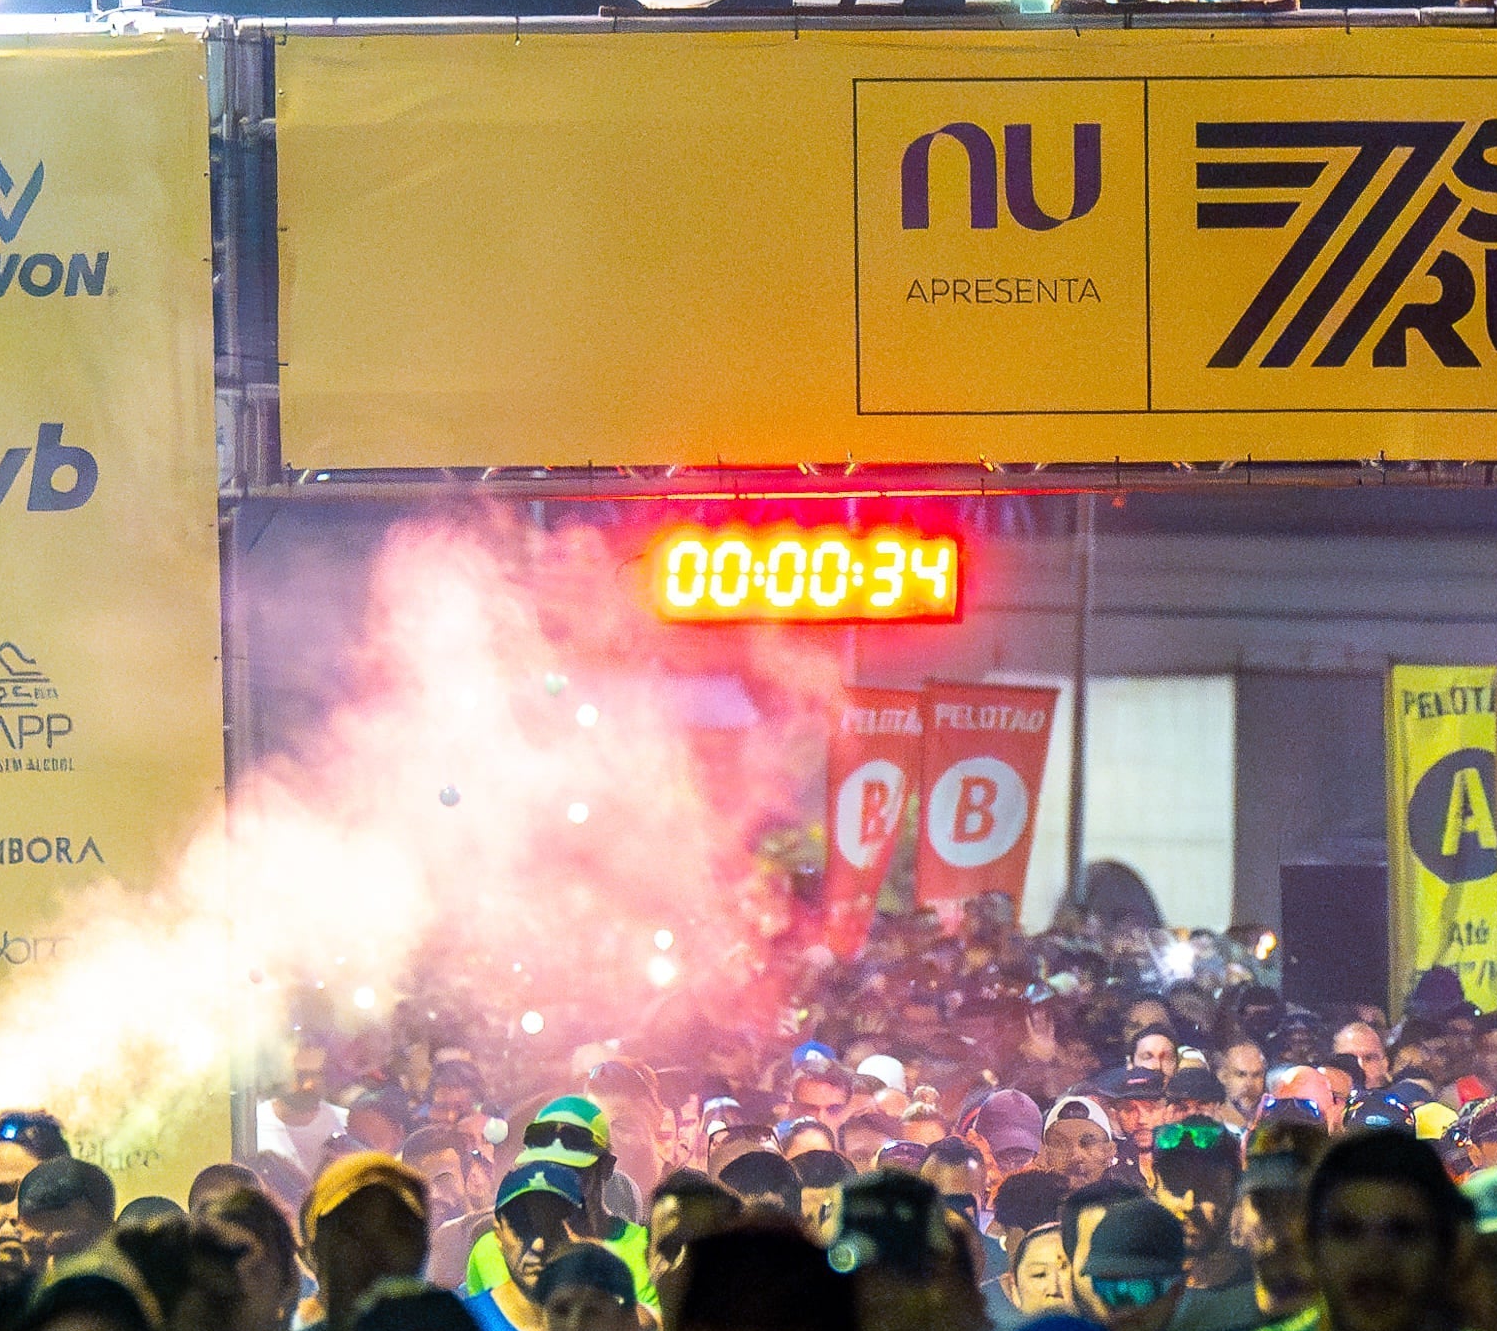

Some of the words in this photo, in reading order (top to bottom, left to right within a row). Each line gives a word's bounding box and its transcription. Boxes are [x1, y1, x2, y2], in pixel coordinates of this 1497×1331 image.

[901, 122, 1102, 231] nu
[906, 278, 1102, 304] APRESENTA
[666, 541, 950, 607] 00:00:34
[951, 776, 998, 844] B
[1442, 768, 1497, 856] A
